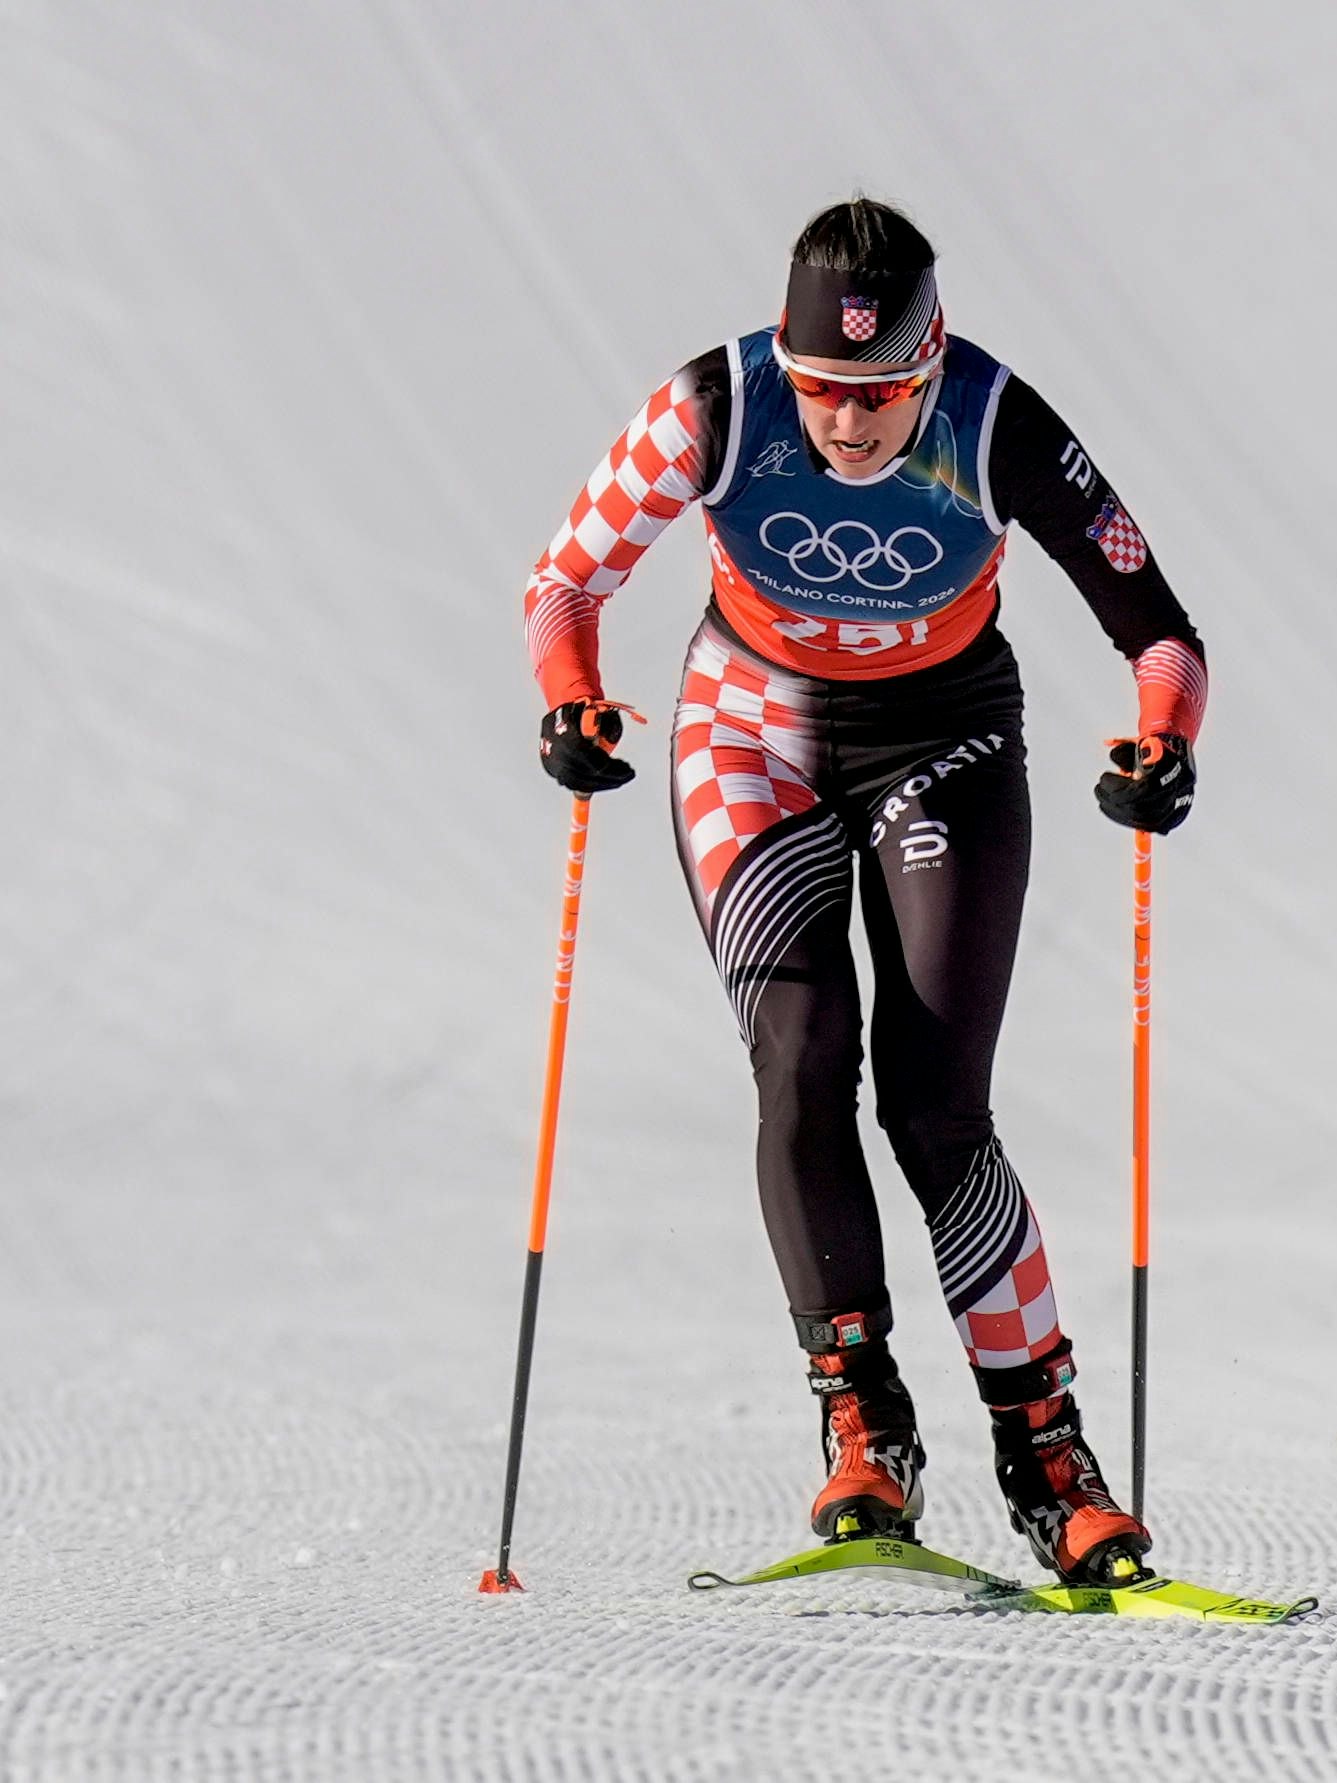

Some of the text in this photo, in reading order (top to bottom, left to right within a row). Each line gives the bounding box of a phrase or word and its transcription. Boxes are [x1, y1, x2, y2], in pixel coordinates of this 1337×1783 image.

[747, 568, 956, 610] MILANO CORTINA 2026
